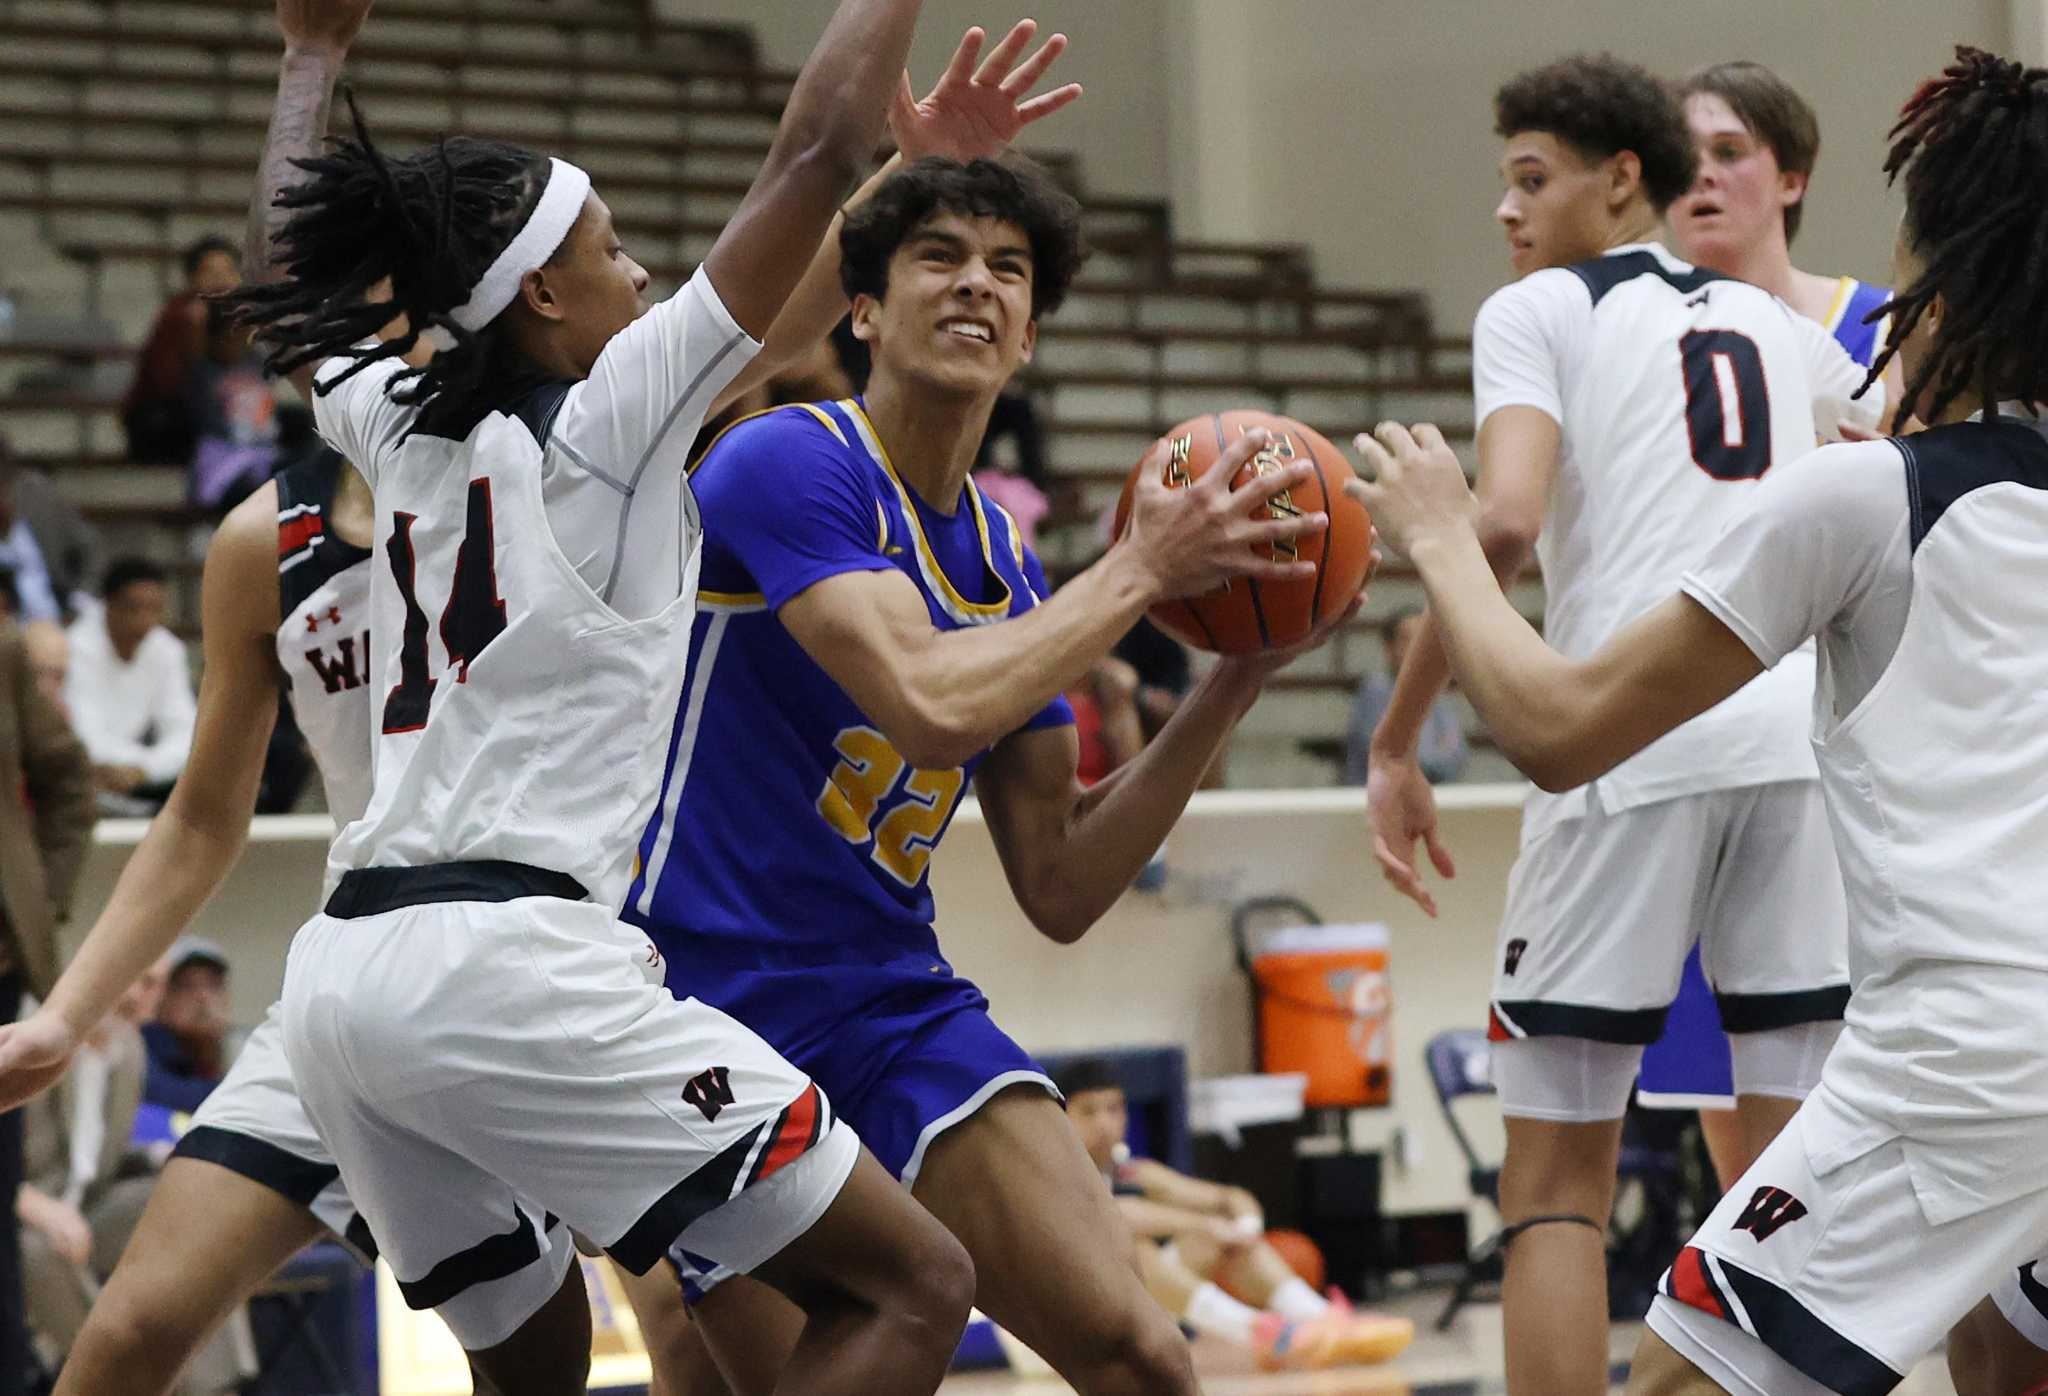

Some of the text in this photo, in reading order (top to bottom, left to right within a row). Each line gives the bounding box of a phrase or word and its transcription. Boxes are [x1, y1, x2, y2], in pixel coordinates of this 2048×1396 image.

[1679, 327, 1772, 480] 0
[382, 476, 508, 735] 14
[305, 629, 370, 693] W
[816, 725, 965, 888] 32
[681, 1066, 737, 1124] W
[1730, 1186, 1808, 1243] W
